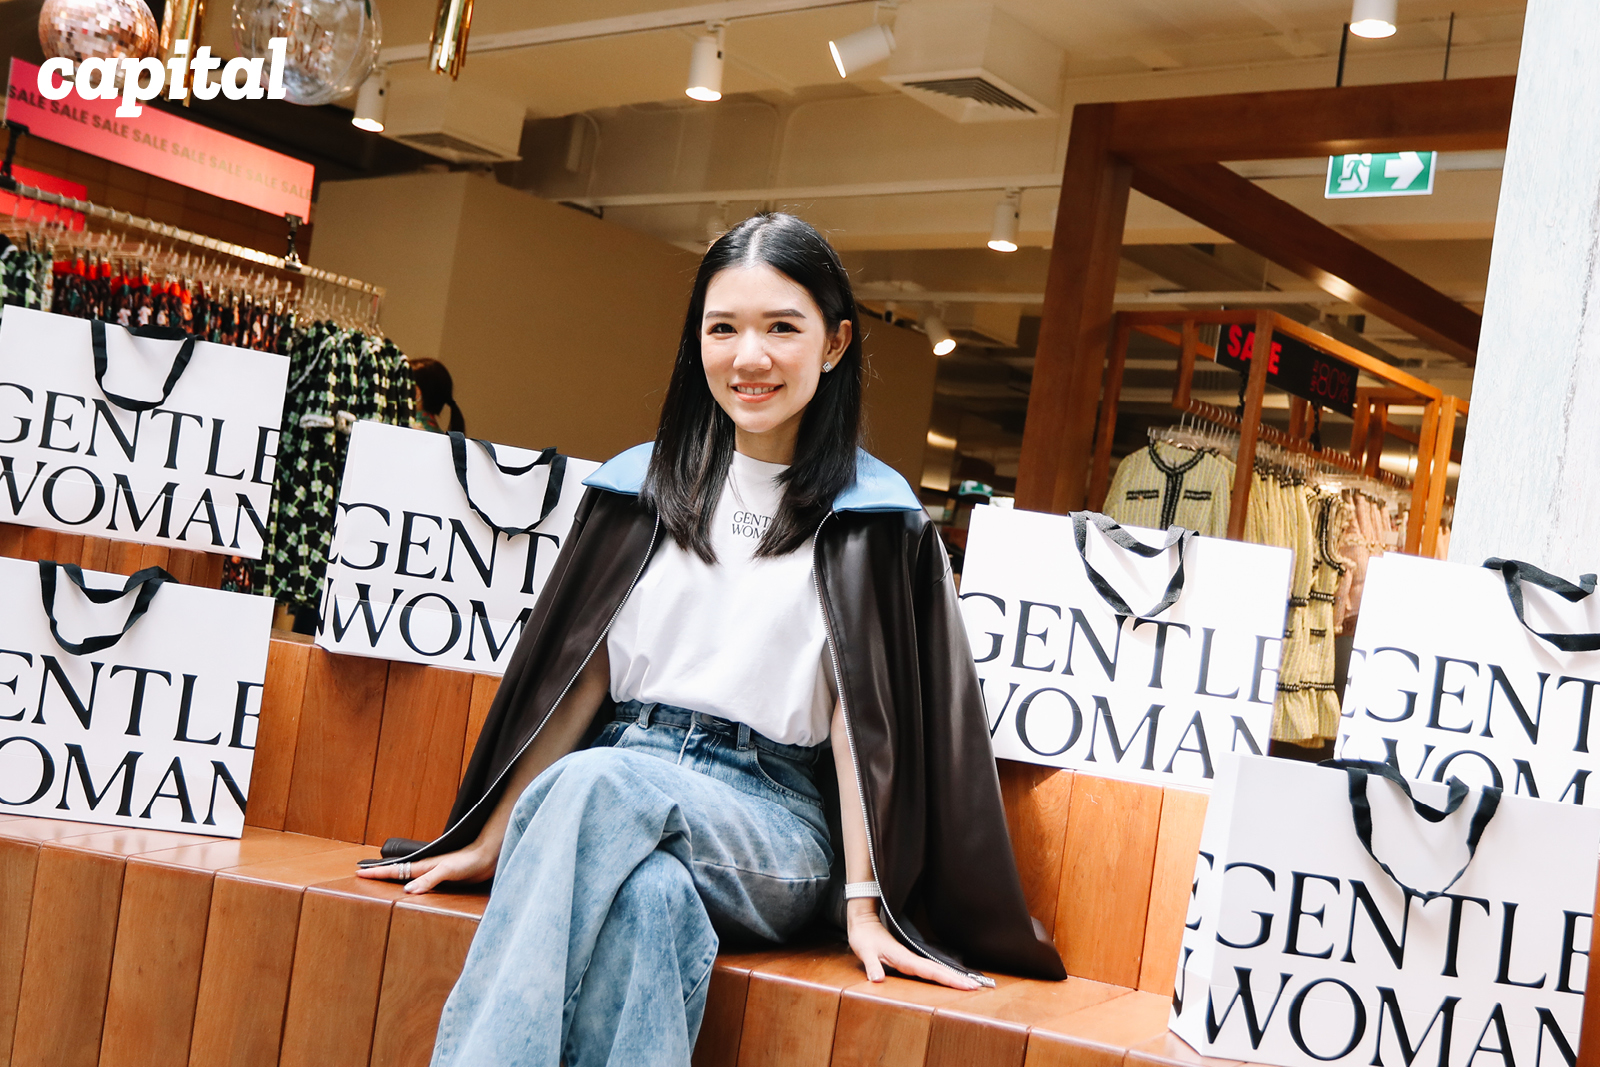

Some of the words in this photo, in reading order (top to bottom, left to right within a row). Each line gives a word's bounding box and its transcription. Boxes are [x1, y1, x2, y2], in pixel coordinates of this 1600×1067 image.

[9, 85, 47, 110] SALE
[50, 100, 89, 125] SALE
[92, 115, 129, 139] SALE
[132, 129, 168, 151] SALE
[172, 142, 205, 165] SALE
[210, 155, 242, 178] SALE
[246, 168, 278, 190] SALE
[281, 181, 312, 200] SALE
[1227, 324, 1282, 376] SAE
[733, 511, 772, 528] GENT
[1216, 861, 1593, 995] GENTLE
